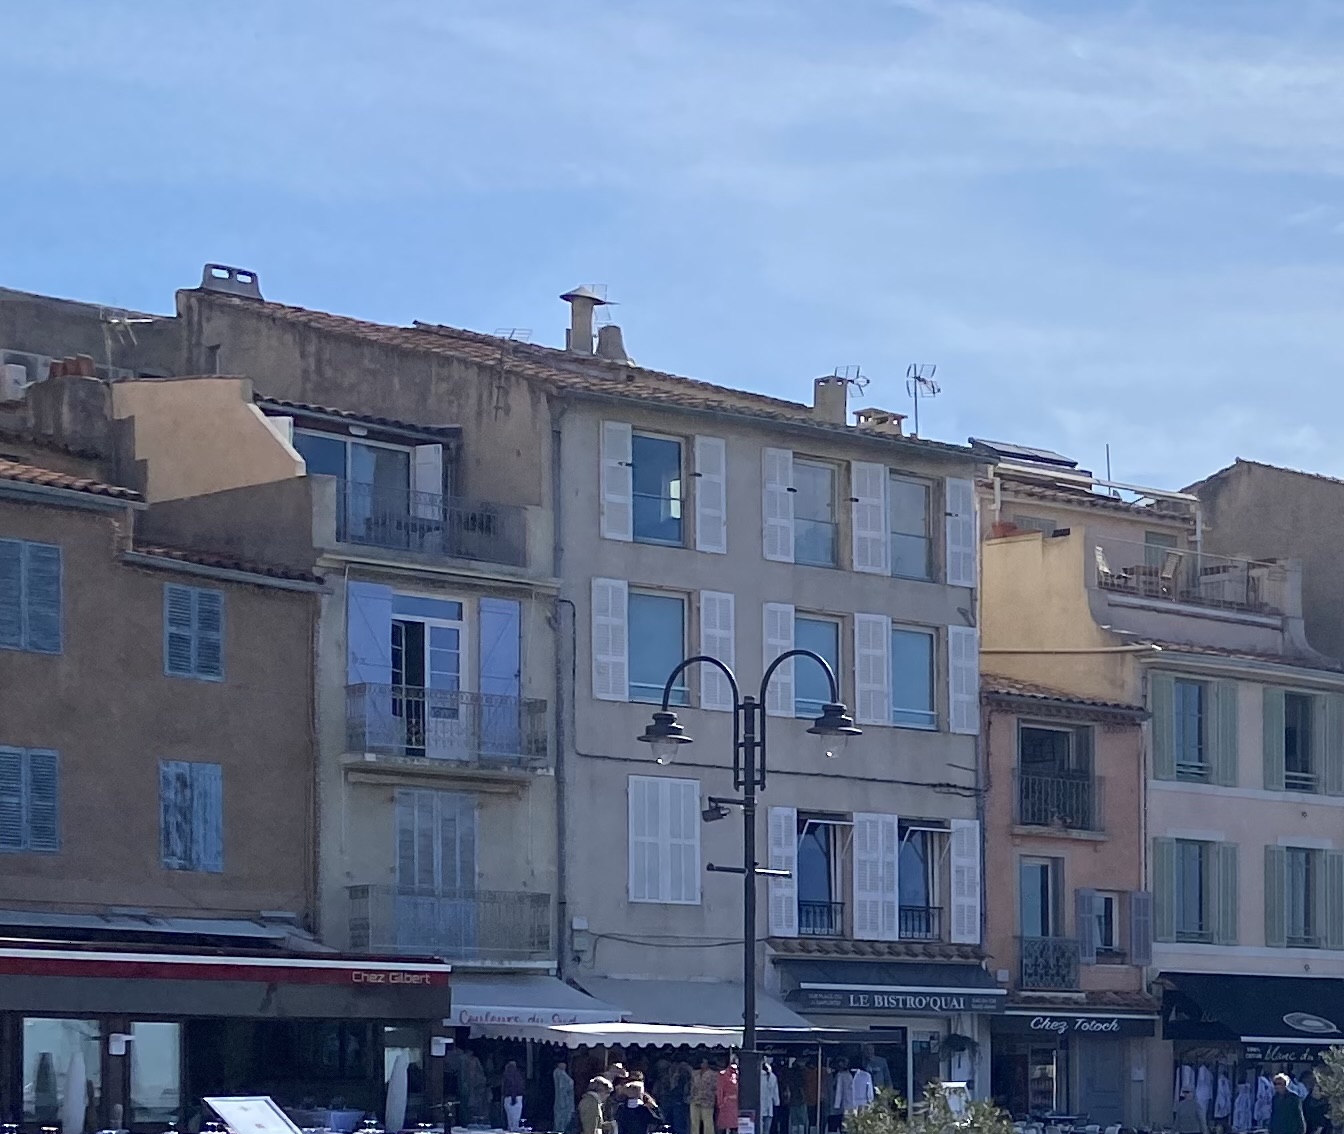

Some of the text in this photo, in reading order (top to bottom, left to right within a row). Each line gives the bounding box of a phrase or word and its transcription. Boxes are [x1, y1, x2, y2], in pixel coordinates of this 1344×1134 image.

[352, 971, 431, 984] Chez Gilbert
[850, 994, 870, 1008] LE
[873, 995, 965, 1012] BISTRO'QUAI
[1030, 1016, 1120, 1034] Chez Totoch
